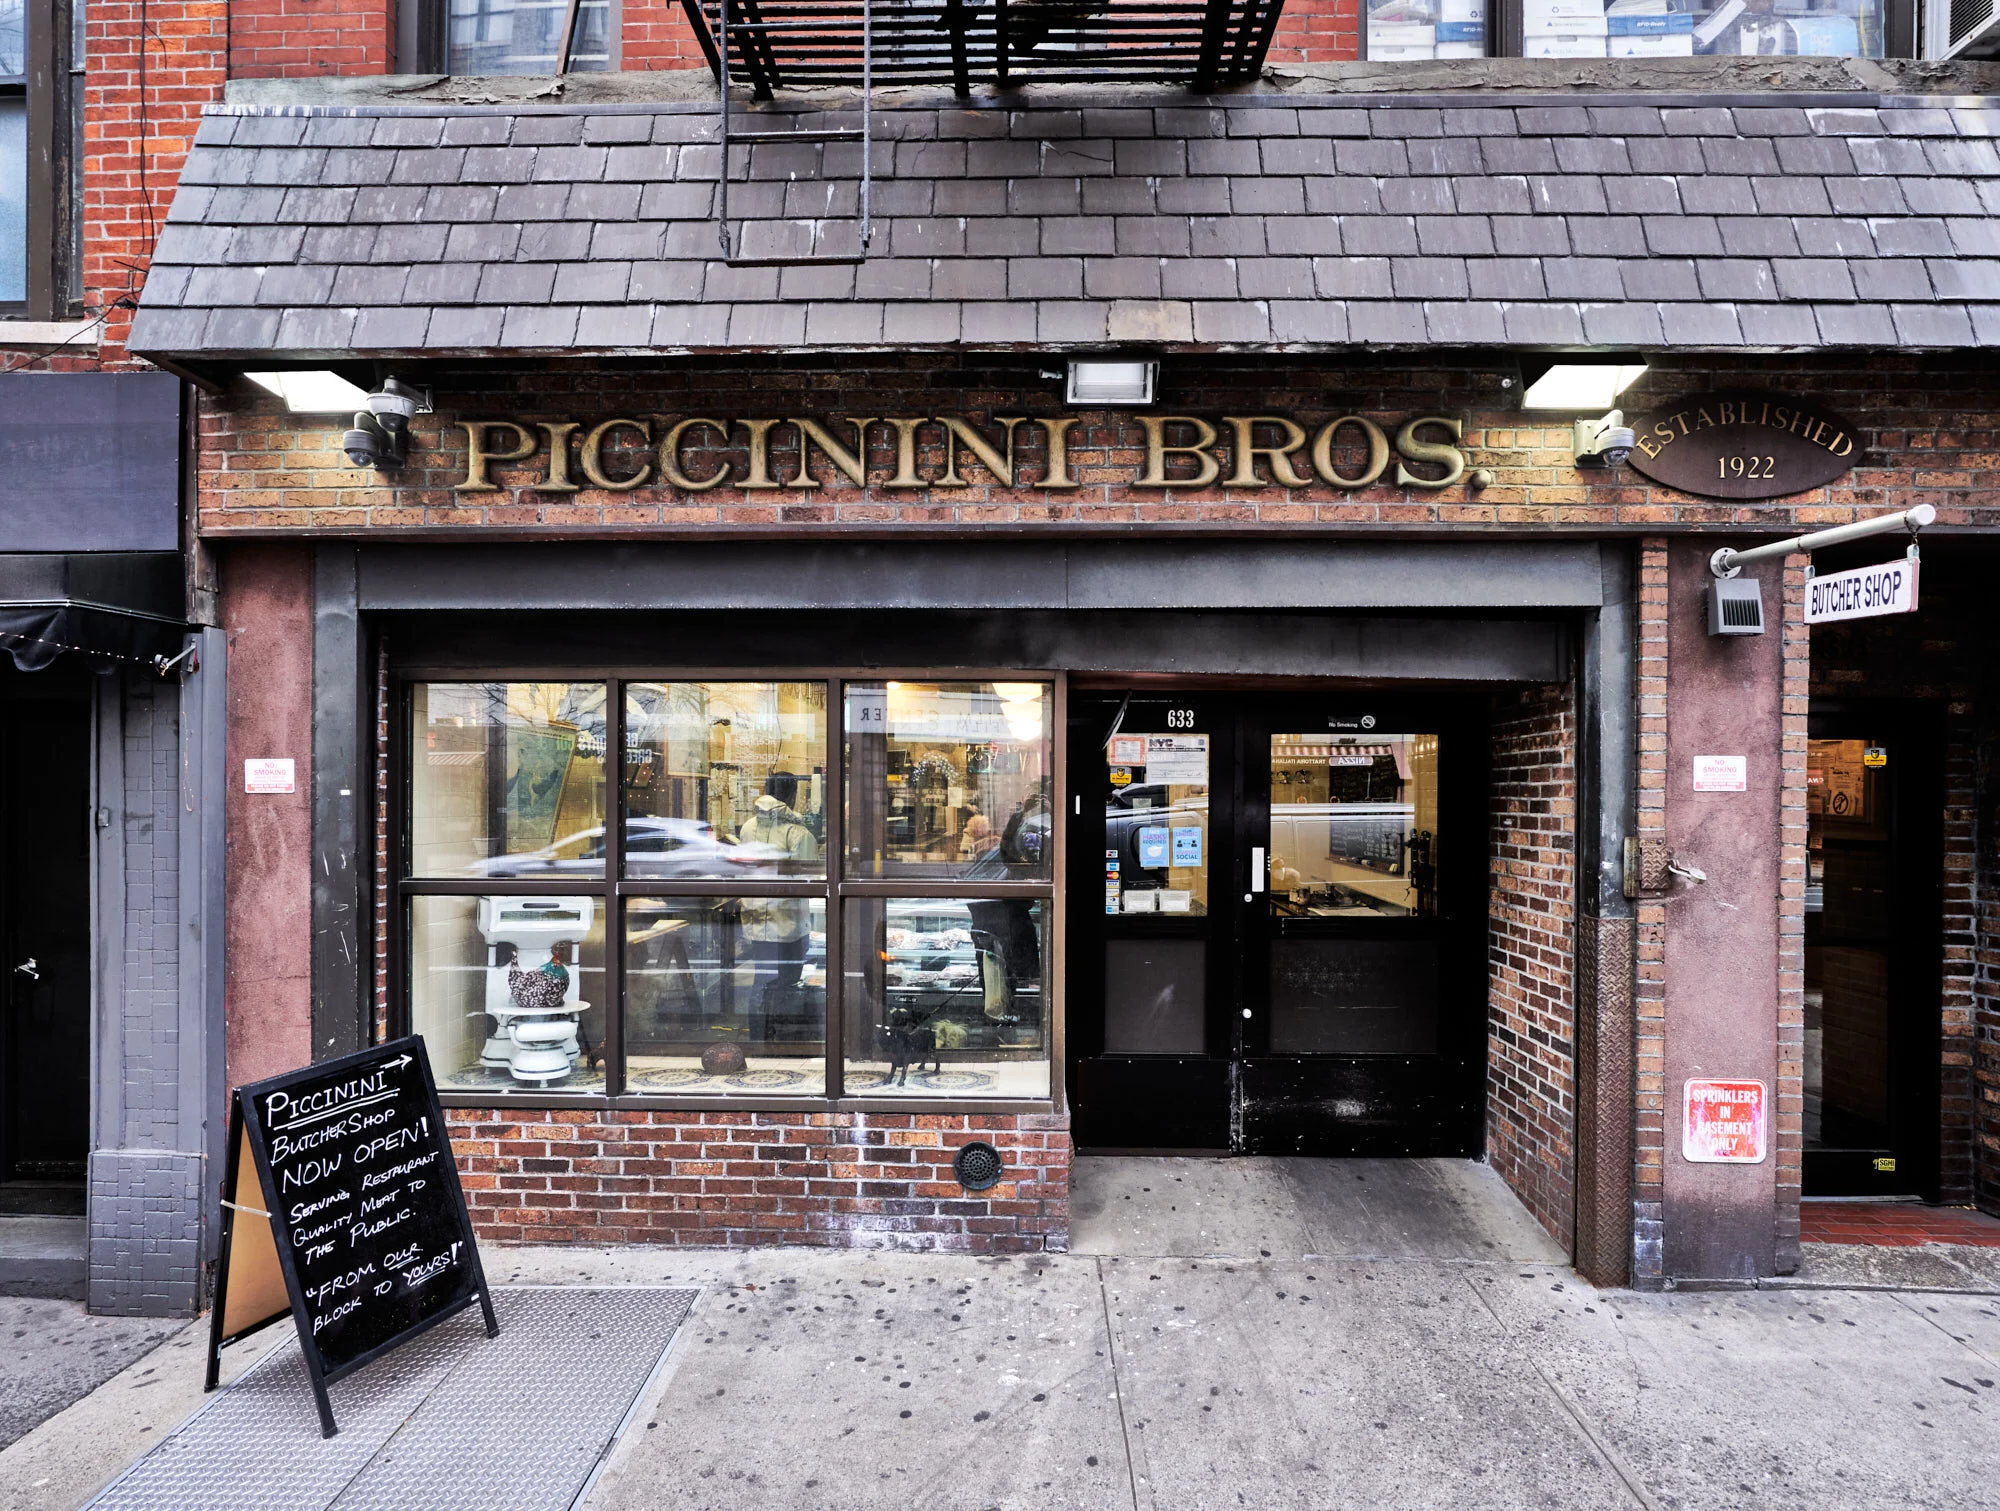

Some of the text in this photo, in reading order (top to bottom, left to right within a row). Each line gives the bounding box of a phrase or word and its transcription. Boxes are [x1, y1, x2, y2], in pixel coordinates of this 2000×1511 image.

[454, 415, 1491, 491] PICCININI BROS.
[1636, 401, 1853, 459] ESTABLISHED
[1718, 456, 1776, 479] 1922
[1811, 570, 1902, 616] BUTCHER SHOP
[1167, 709, 1195, 728] 633
[1336, 721, 1358, 729] Smoking
[265, 1071, 388, 1127] PICCININI
[1692, 1089, 1759, 1104] SPRINKLERS
[1720, 1105, 1731, 1119] IN
[1698, 1121, 1752, 1135] BASEMENT
[1712, 1137, 1739, 1151] ONLY
[282, 1116, 430, 1194] NOW OPEN!
[290, 1151, 439, 1224] SERVING RESTAURANT
[293, 1180, 426, 1247] QUALITY MEAT TO
[305, 1208, 417, 1265] THE PUBLIC.
[383, 1242, 422, 1267] OUR
[313, 1296, 362, 1336] BLOCK
[374, 1280, 393, 1297] TO
